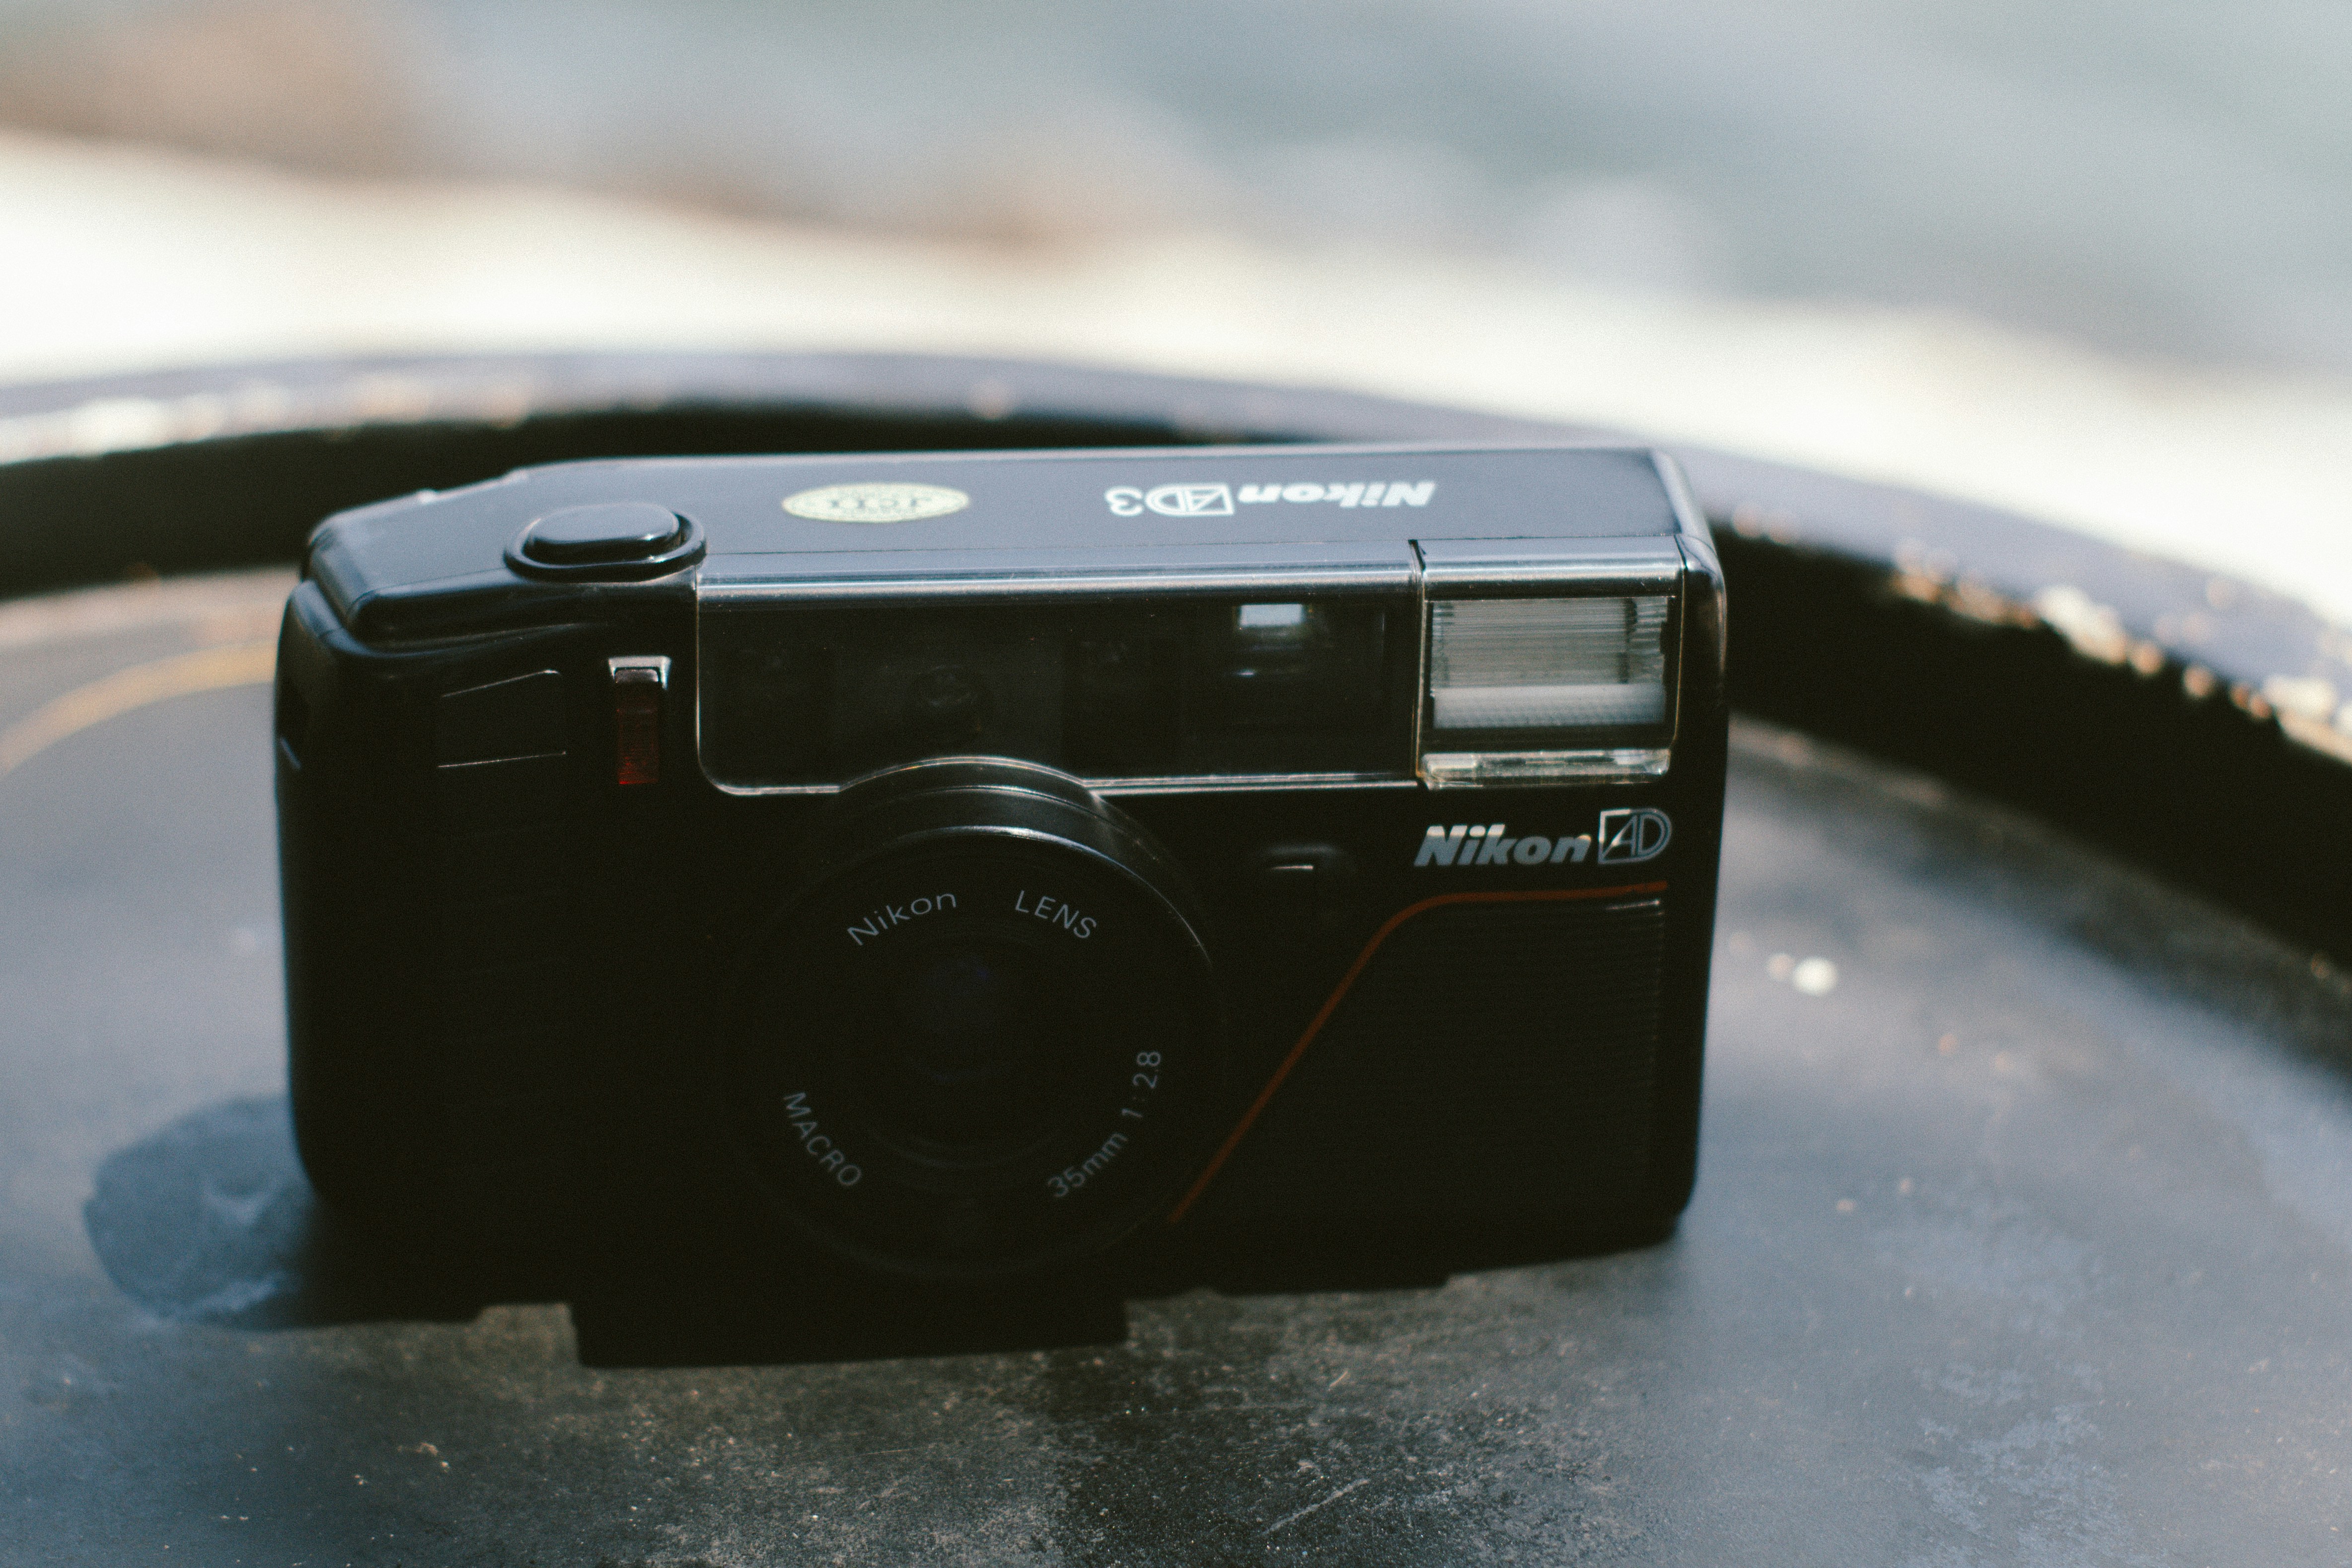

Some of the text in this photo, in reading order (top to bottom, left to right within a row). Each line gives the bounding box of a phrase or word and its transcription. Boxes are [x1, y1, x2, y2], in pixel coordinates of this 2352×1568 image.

[1238, 481, 1436, 509] Nikon
[1413, 808, 1673, 867] Nikon AD
[846, 890, 1098, 946] Nikon LENS
[782, 1092, 862, 1186] MACRO
[1047, 1132, 1128, 1197] 35mm
